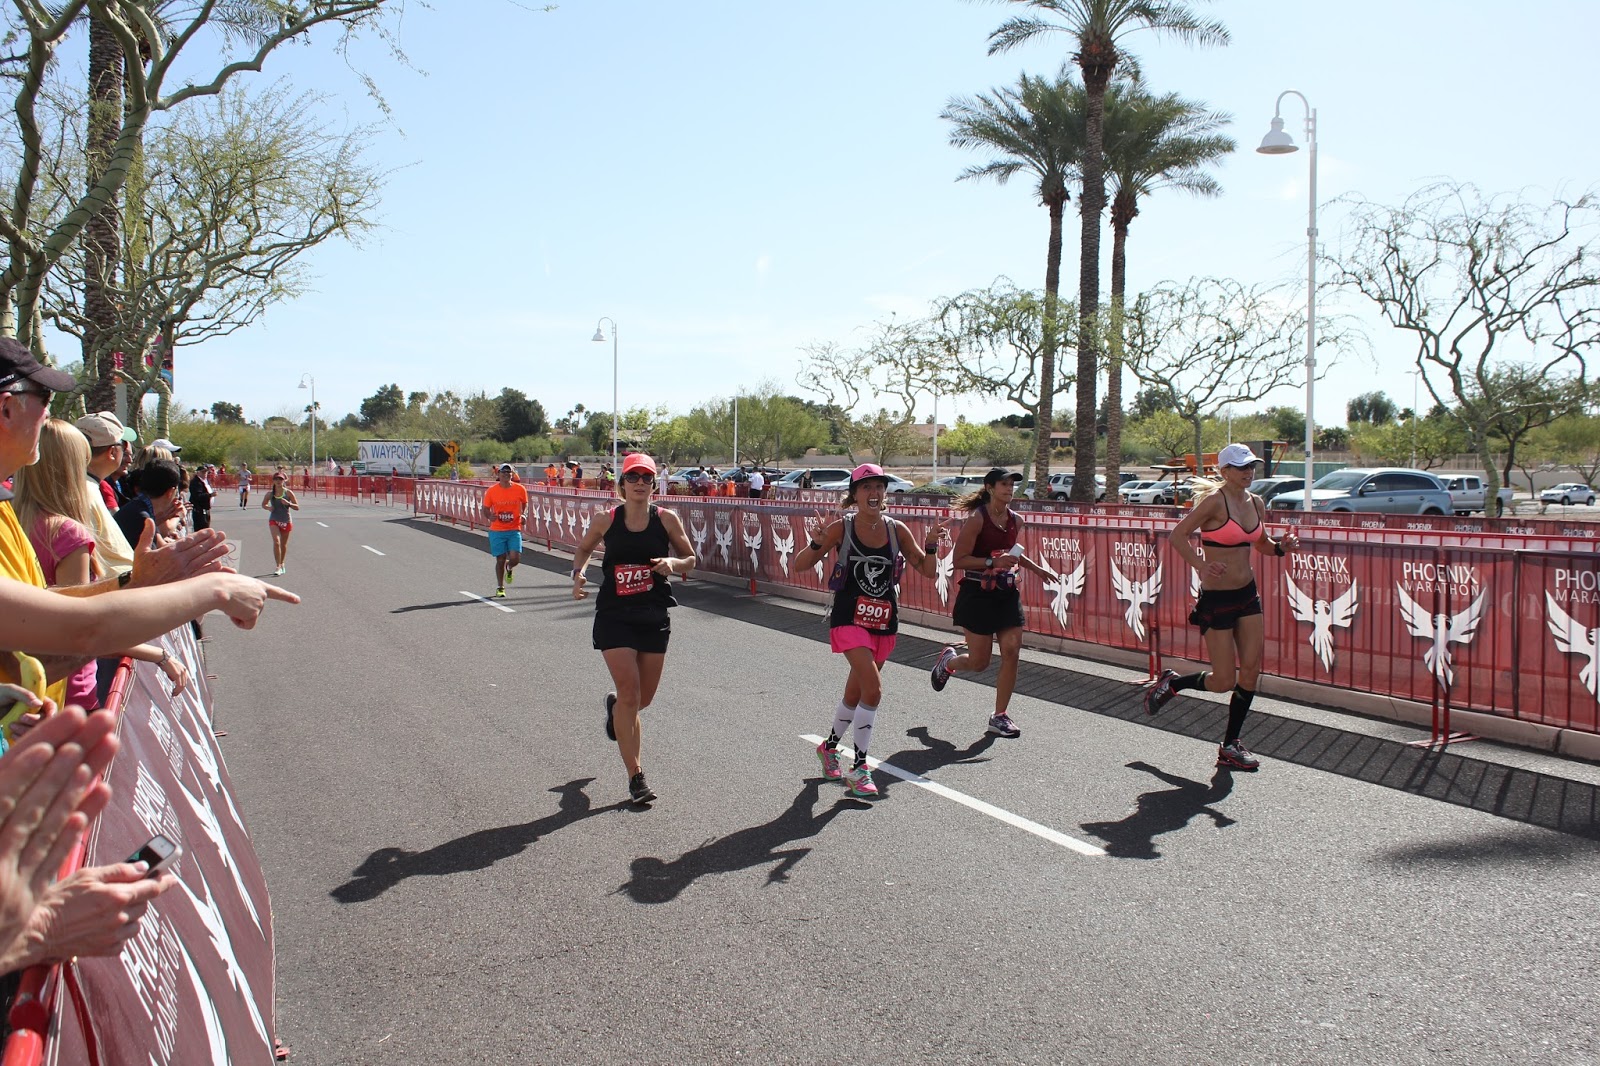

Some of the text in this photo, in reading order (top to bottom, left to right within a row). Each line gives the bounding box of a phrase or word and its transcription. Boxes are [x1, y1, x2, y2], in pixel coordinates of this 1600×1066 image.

[1280, 517, 1301, 525] PHOENIX
[1318, 518, 1341, 526] PHOENIX
[1361, 520, 1385, 528] PHOENIX
[1454, 524, 1482, 533] PHOENIX
[1506, 526, 1537, 535] PHOENIX
[1563, 528, 1596, 538] PHOENIX
[1042, 537, 1082, 553] PHOENIX
[1114, 541, 1157, 559] PHOENIX
[1044, 549, 1082, 561] MARATHON
[1114, 556, 1158, 568] MARATHON
[1291, 552, 1349, 574] PHOENIX
[616, 569, 651, 584] 9743
[1292, 568, 1351, 585] MARATHON
[1403, 561, 1479, 585] PHOENIX
[1404, 579, 1480, 597] MARATHON
[857, 603, 890, 619] 9901
[153, 914, 180, 1066] MARATHON
